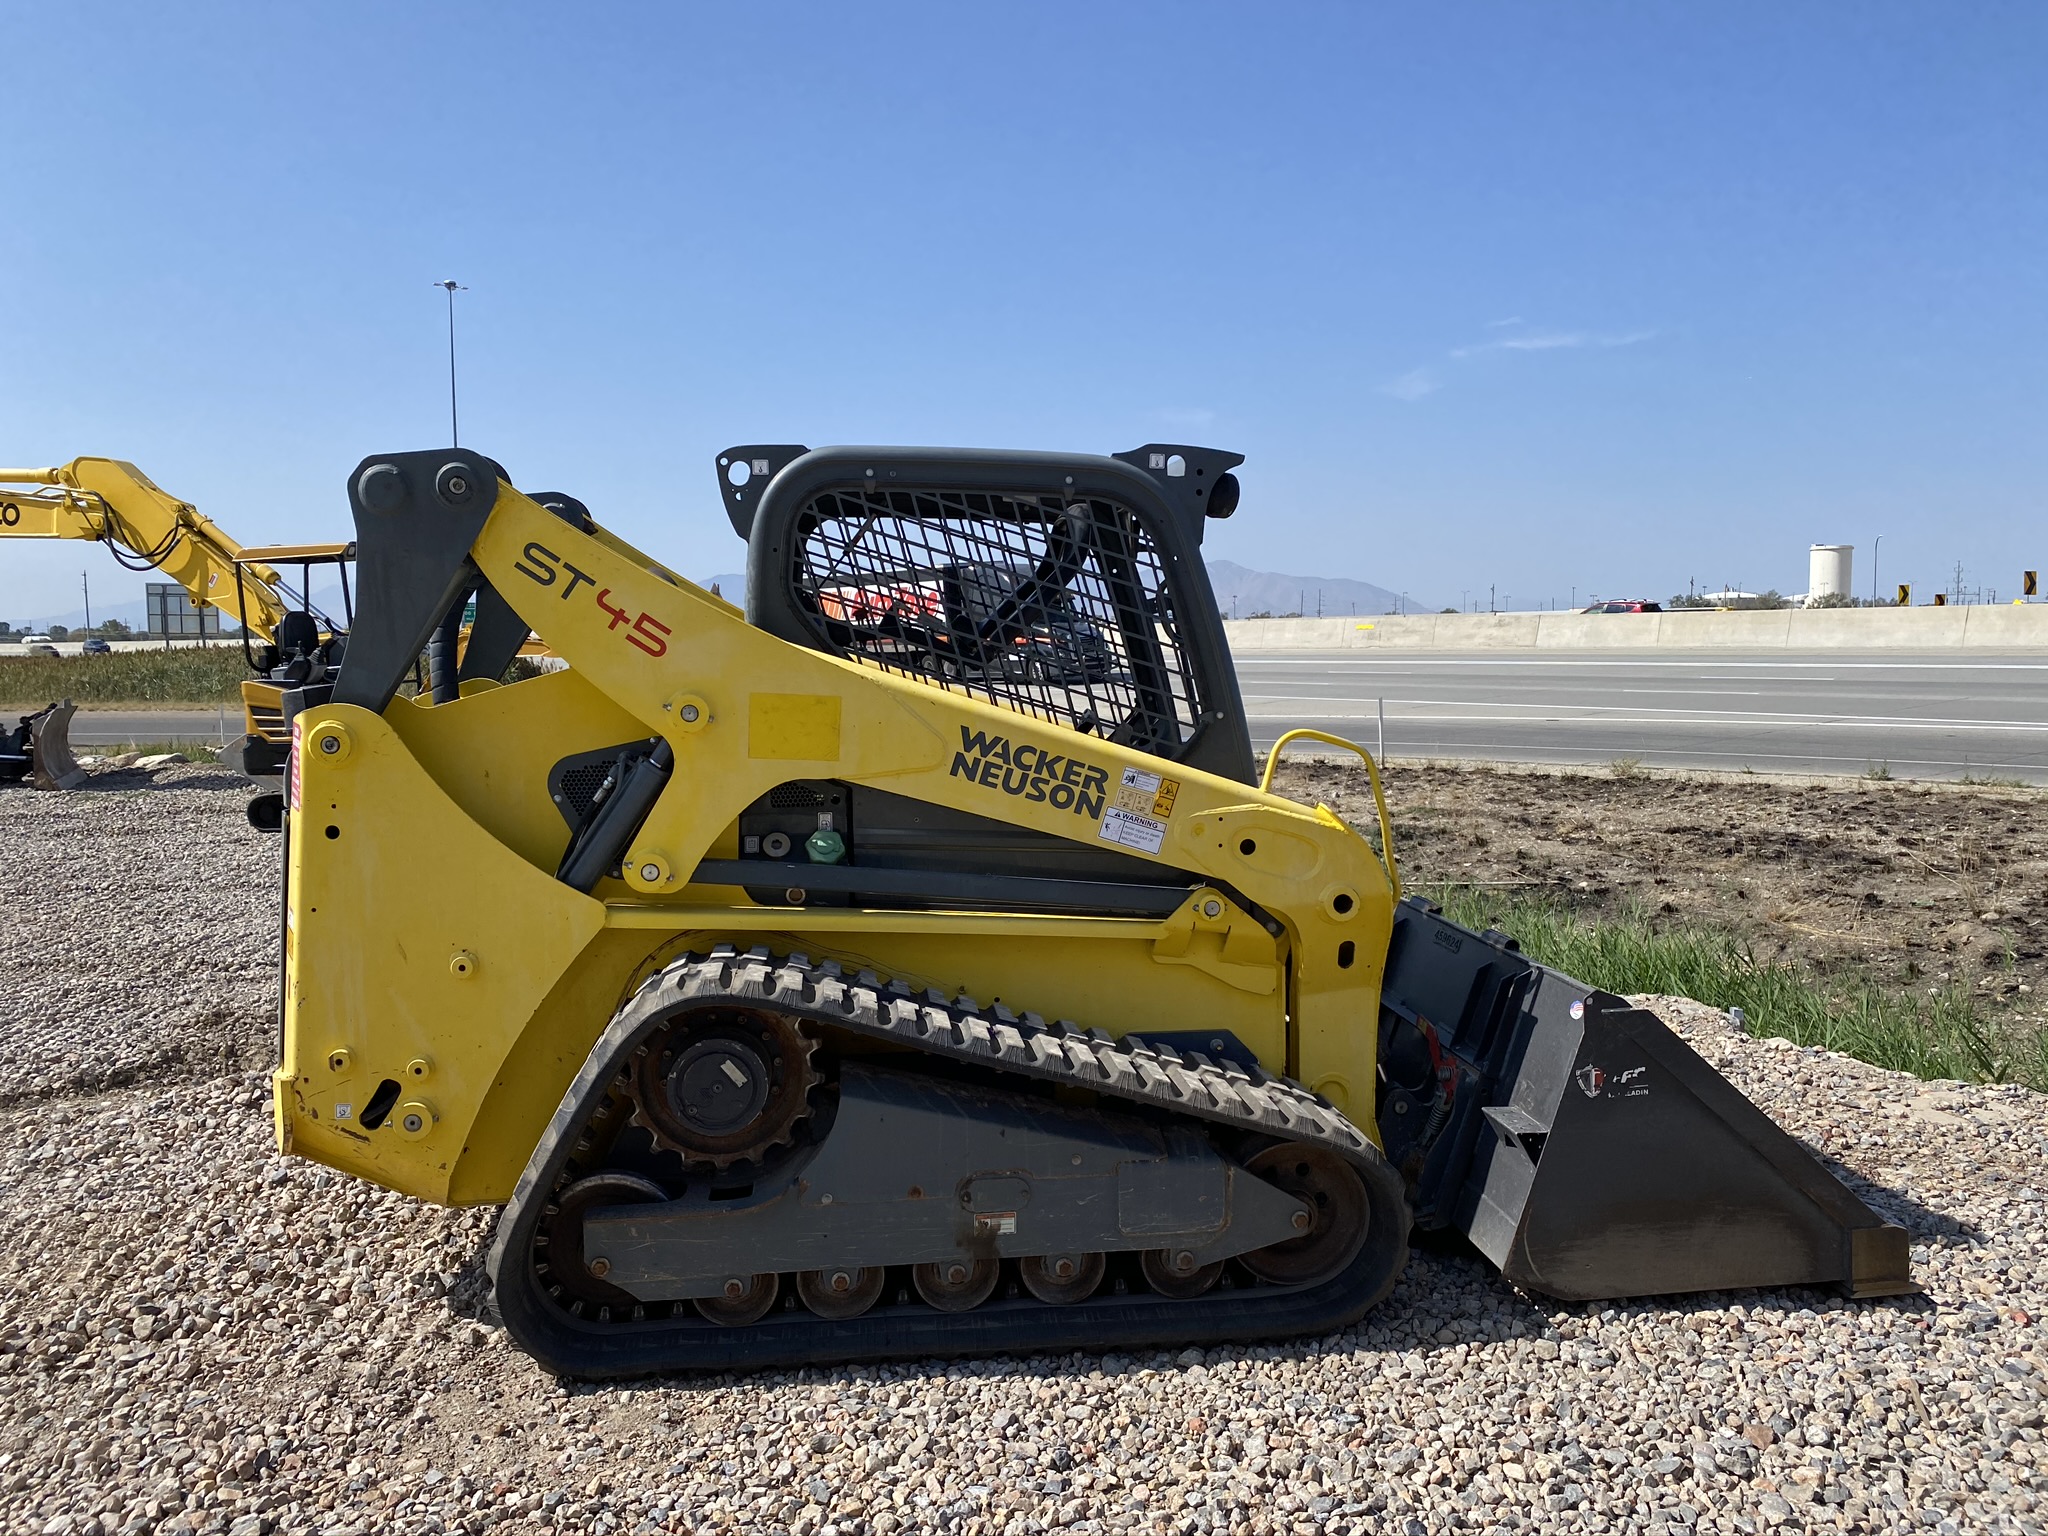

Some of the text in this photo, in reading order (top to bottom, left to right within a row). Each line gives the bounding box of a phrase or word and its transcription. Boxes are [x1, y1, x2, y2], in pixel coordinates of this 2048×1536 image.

[950, 752, 1105, 820] NEUSON
[960, 725, 1109, 795] WACKER
[1122, 812, 1158, 829] WARNING
